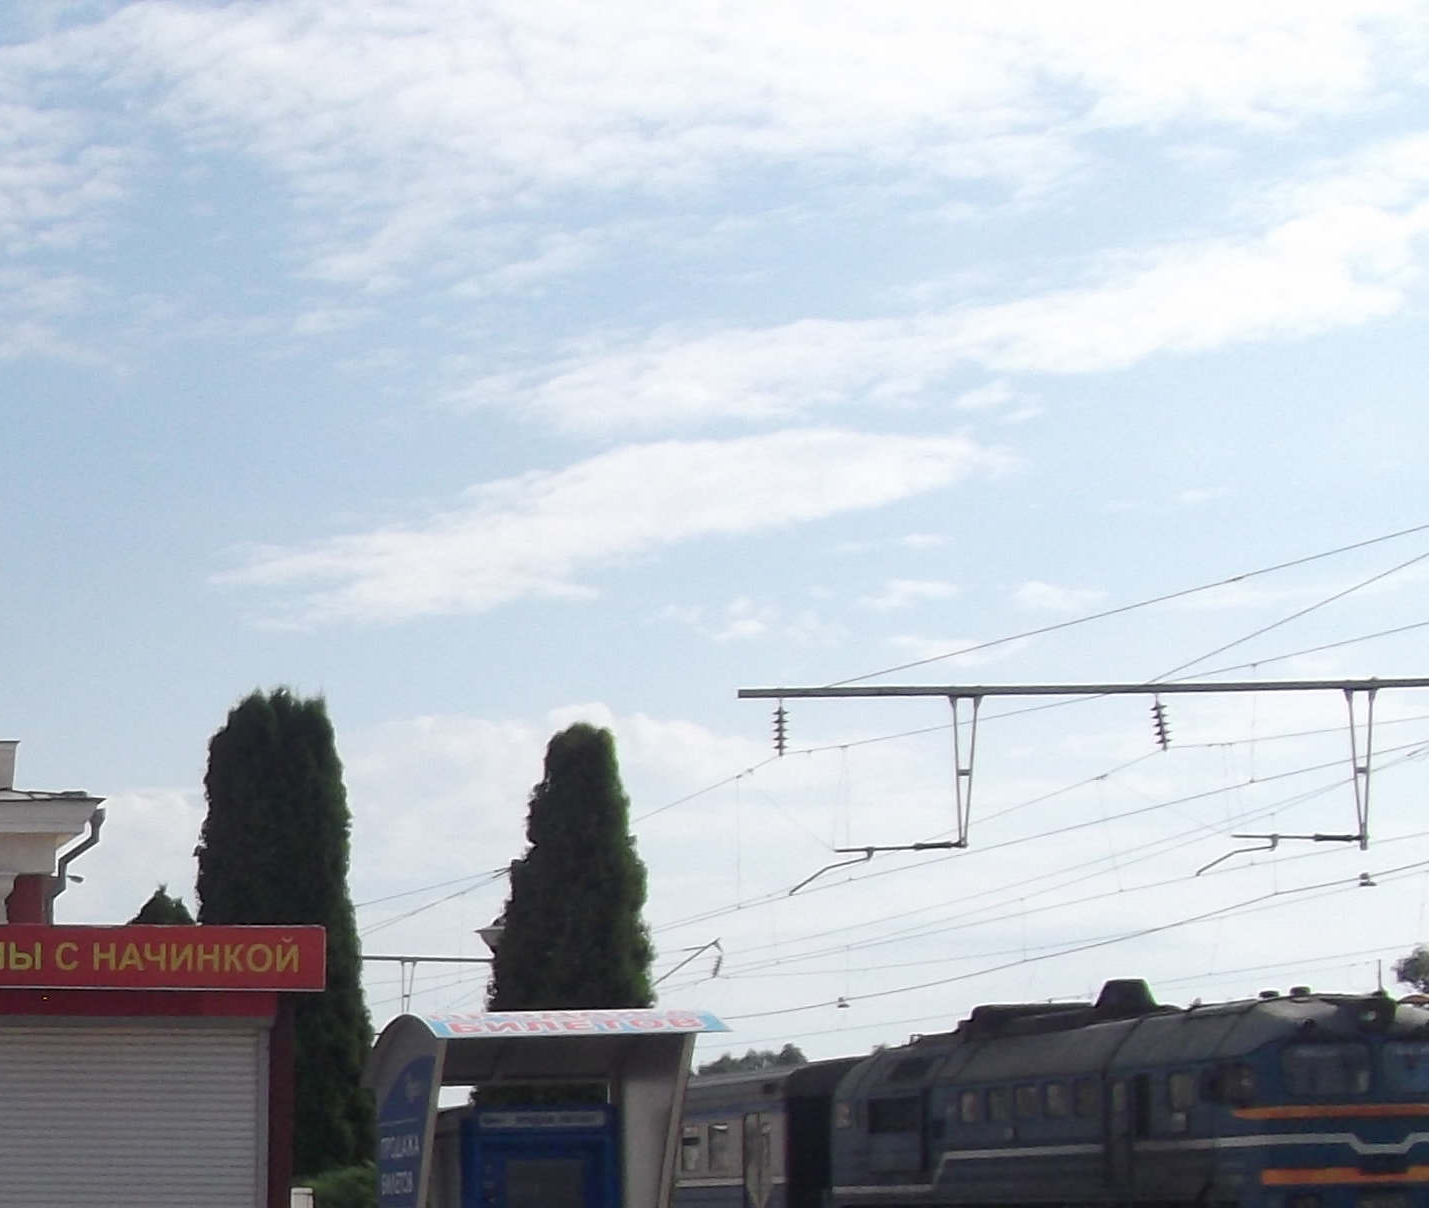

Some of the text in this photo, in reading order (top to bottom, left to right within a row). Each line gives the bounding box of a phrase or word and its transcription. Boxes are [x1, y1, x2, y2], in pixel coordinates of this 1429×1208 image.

[55, 942, 78, 970] С
[92, 936, 300, 973] НАЧИНКОЙ
[447, 1016, 703, 1034] БИЛЕТОВ
